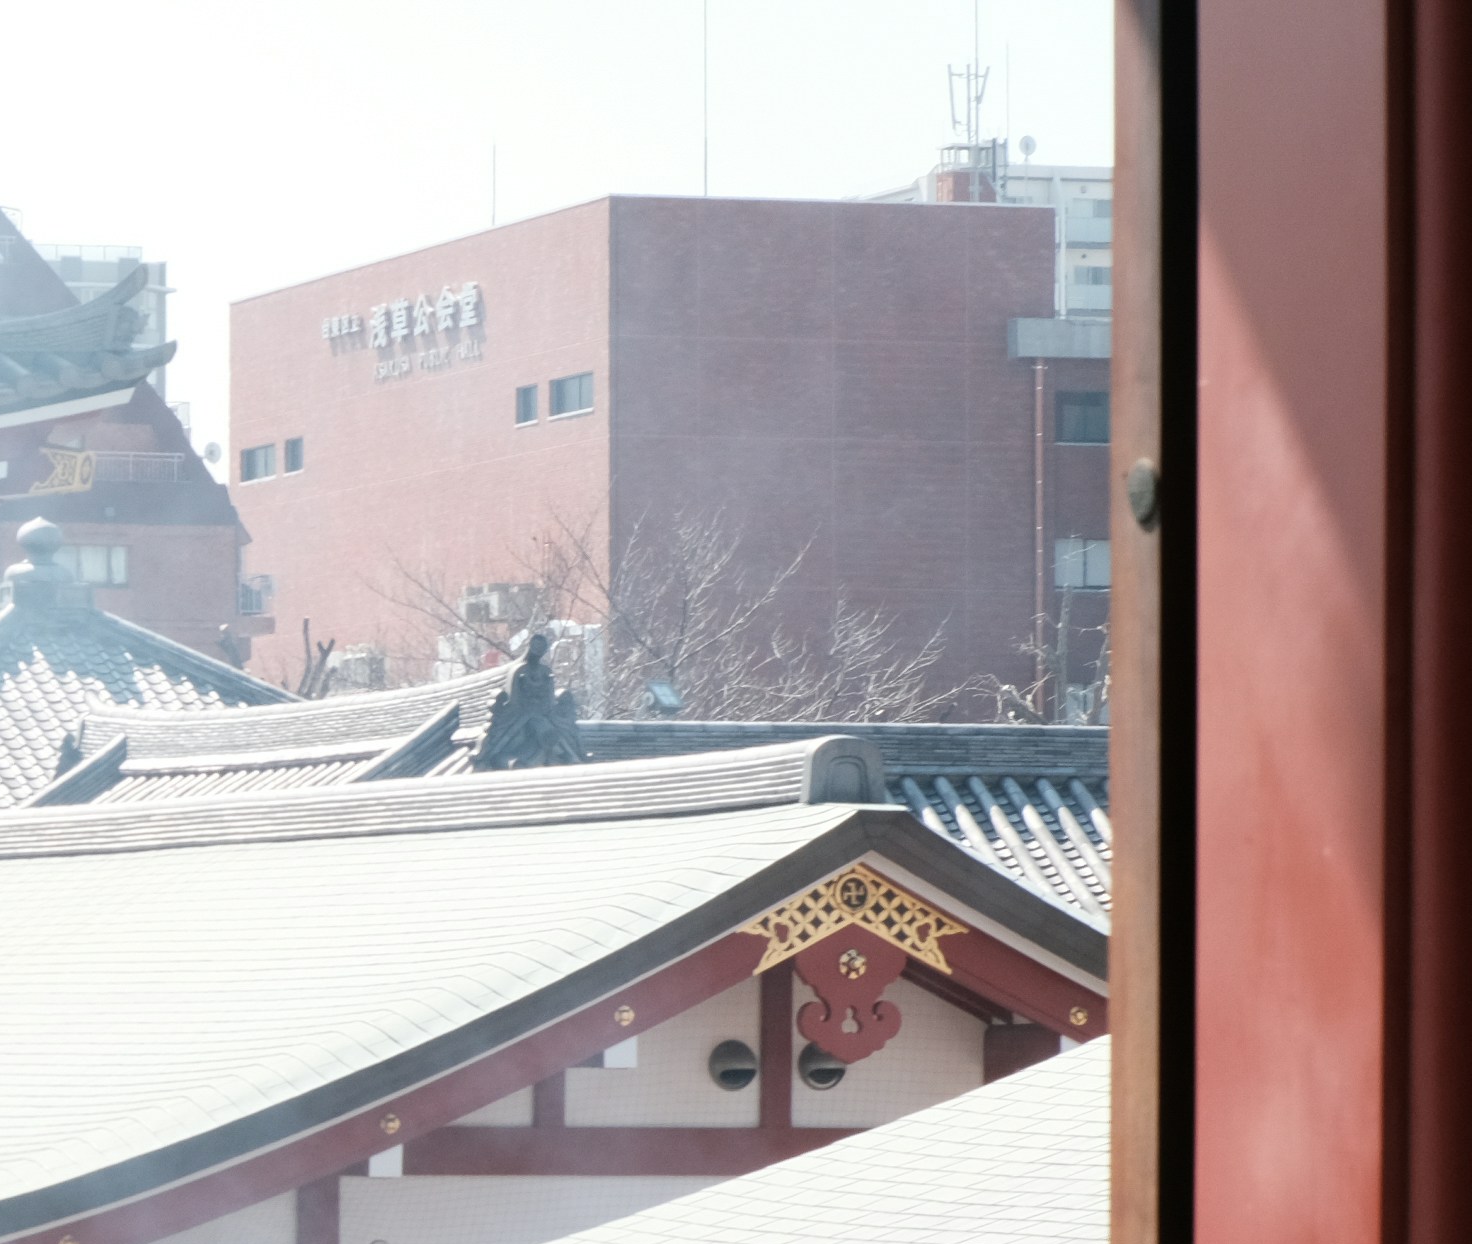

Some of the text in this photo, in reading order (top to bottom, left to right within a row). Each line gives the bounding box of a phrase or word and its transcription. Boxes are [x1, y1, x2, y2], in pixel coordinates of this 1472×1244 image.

[369, 281, 480, 349] 浅草公会堂
